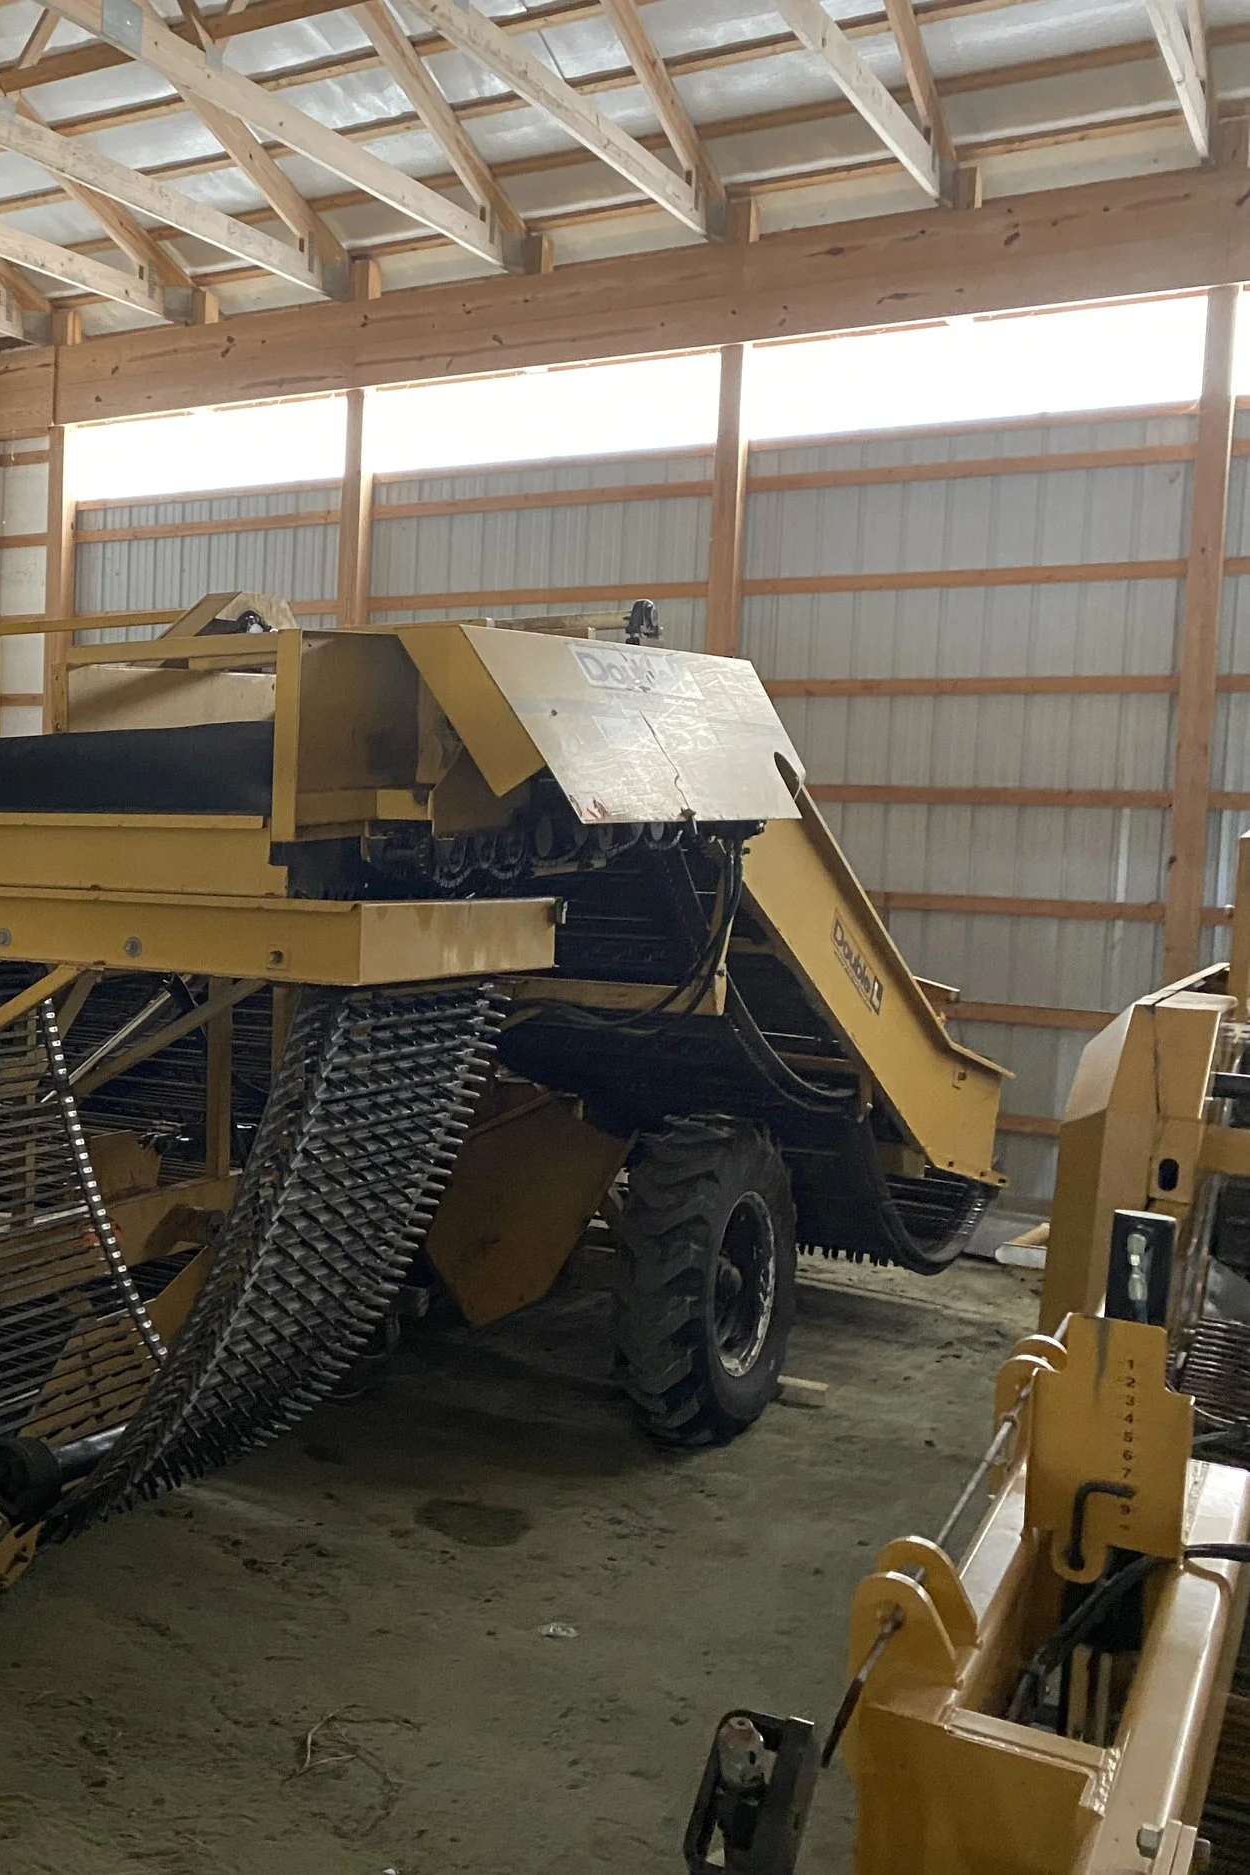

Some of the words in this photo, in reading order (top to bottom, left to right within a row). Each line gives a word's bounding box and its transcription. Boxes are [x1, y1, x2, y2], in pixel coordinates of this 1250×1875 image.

[833, 918, 872, 994] Double
[871, 978, 881, 1012] L
[1127, 1359, 1134, 1369] 1
[1124, 1376, 1136, 1389] 2
[1124, 1413, 1134, 1424] 4
[1123, 1431, 1133, 1443] 5
[1123, 1449, 1133, 1461] 6
[1122, 1467, 1132, 1479] 7
